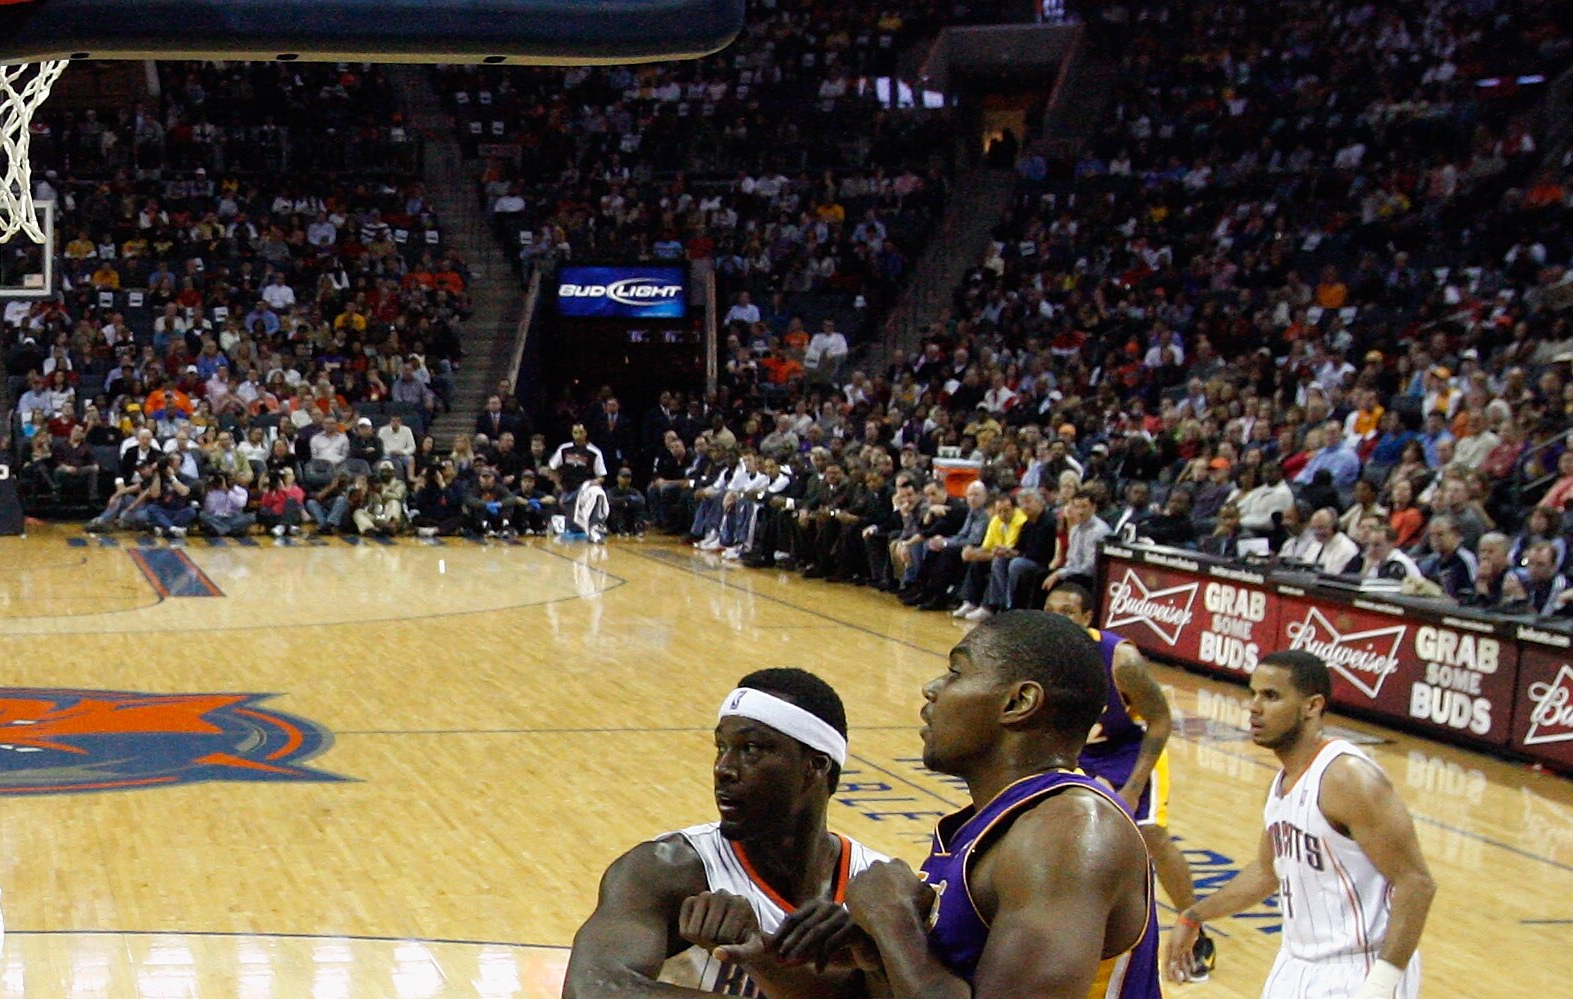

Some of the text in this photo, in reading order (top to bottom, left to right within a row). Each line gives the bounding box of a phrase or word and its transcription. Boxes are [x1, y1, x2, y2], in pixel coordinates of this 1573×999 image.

[558, 284, 682, 297] BUD LIGHT
[1109, 581, 1193, 625] Budweiser
[1204, 582, 1267, 622] GRAB
[1212, 614, 1254, 641] SOME
[1198, 630, 1260, 674] BUDS
[1415, 626, 1500, 674] GRAB
[1426, 662, 1482, 696] SOME
[1409, 681, 1492, 735] BUDS
